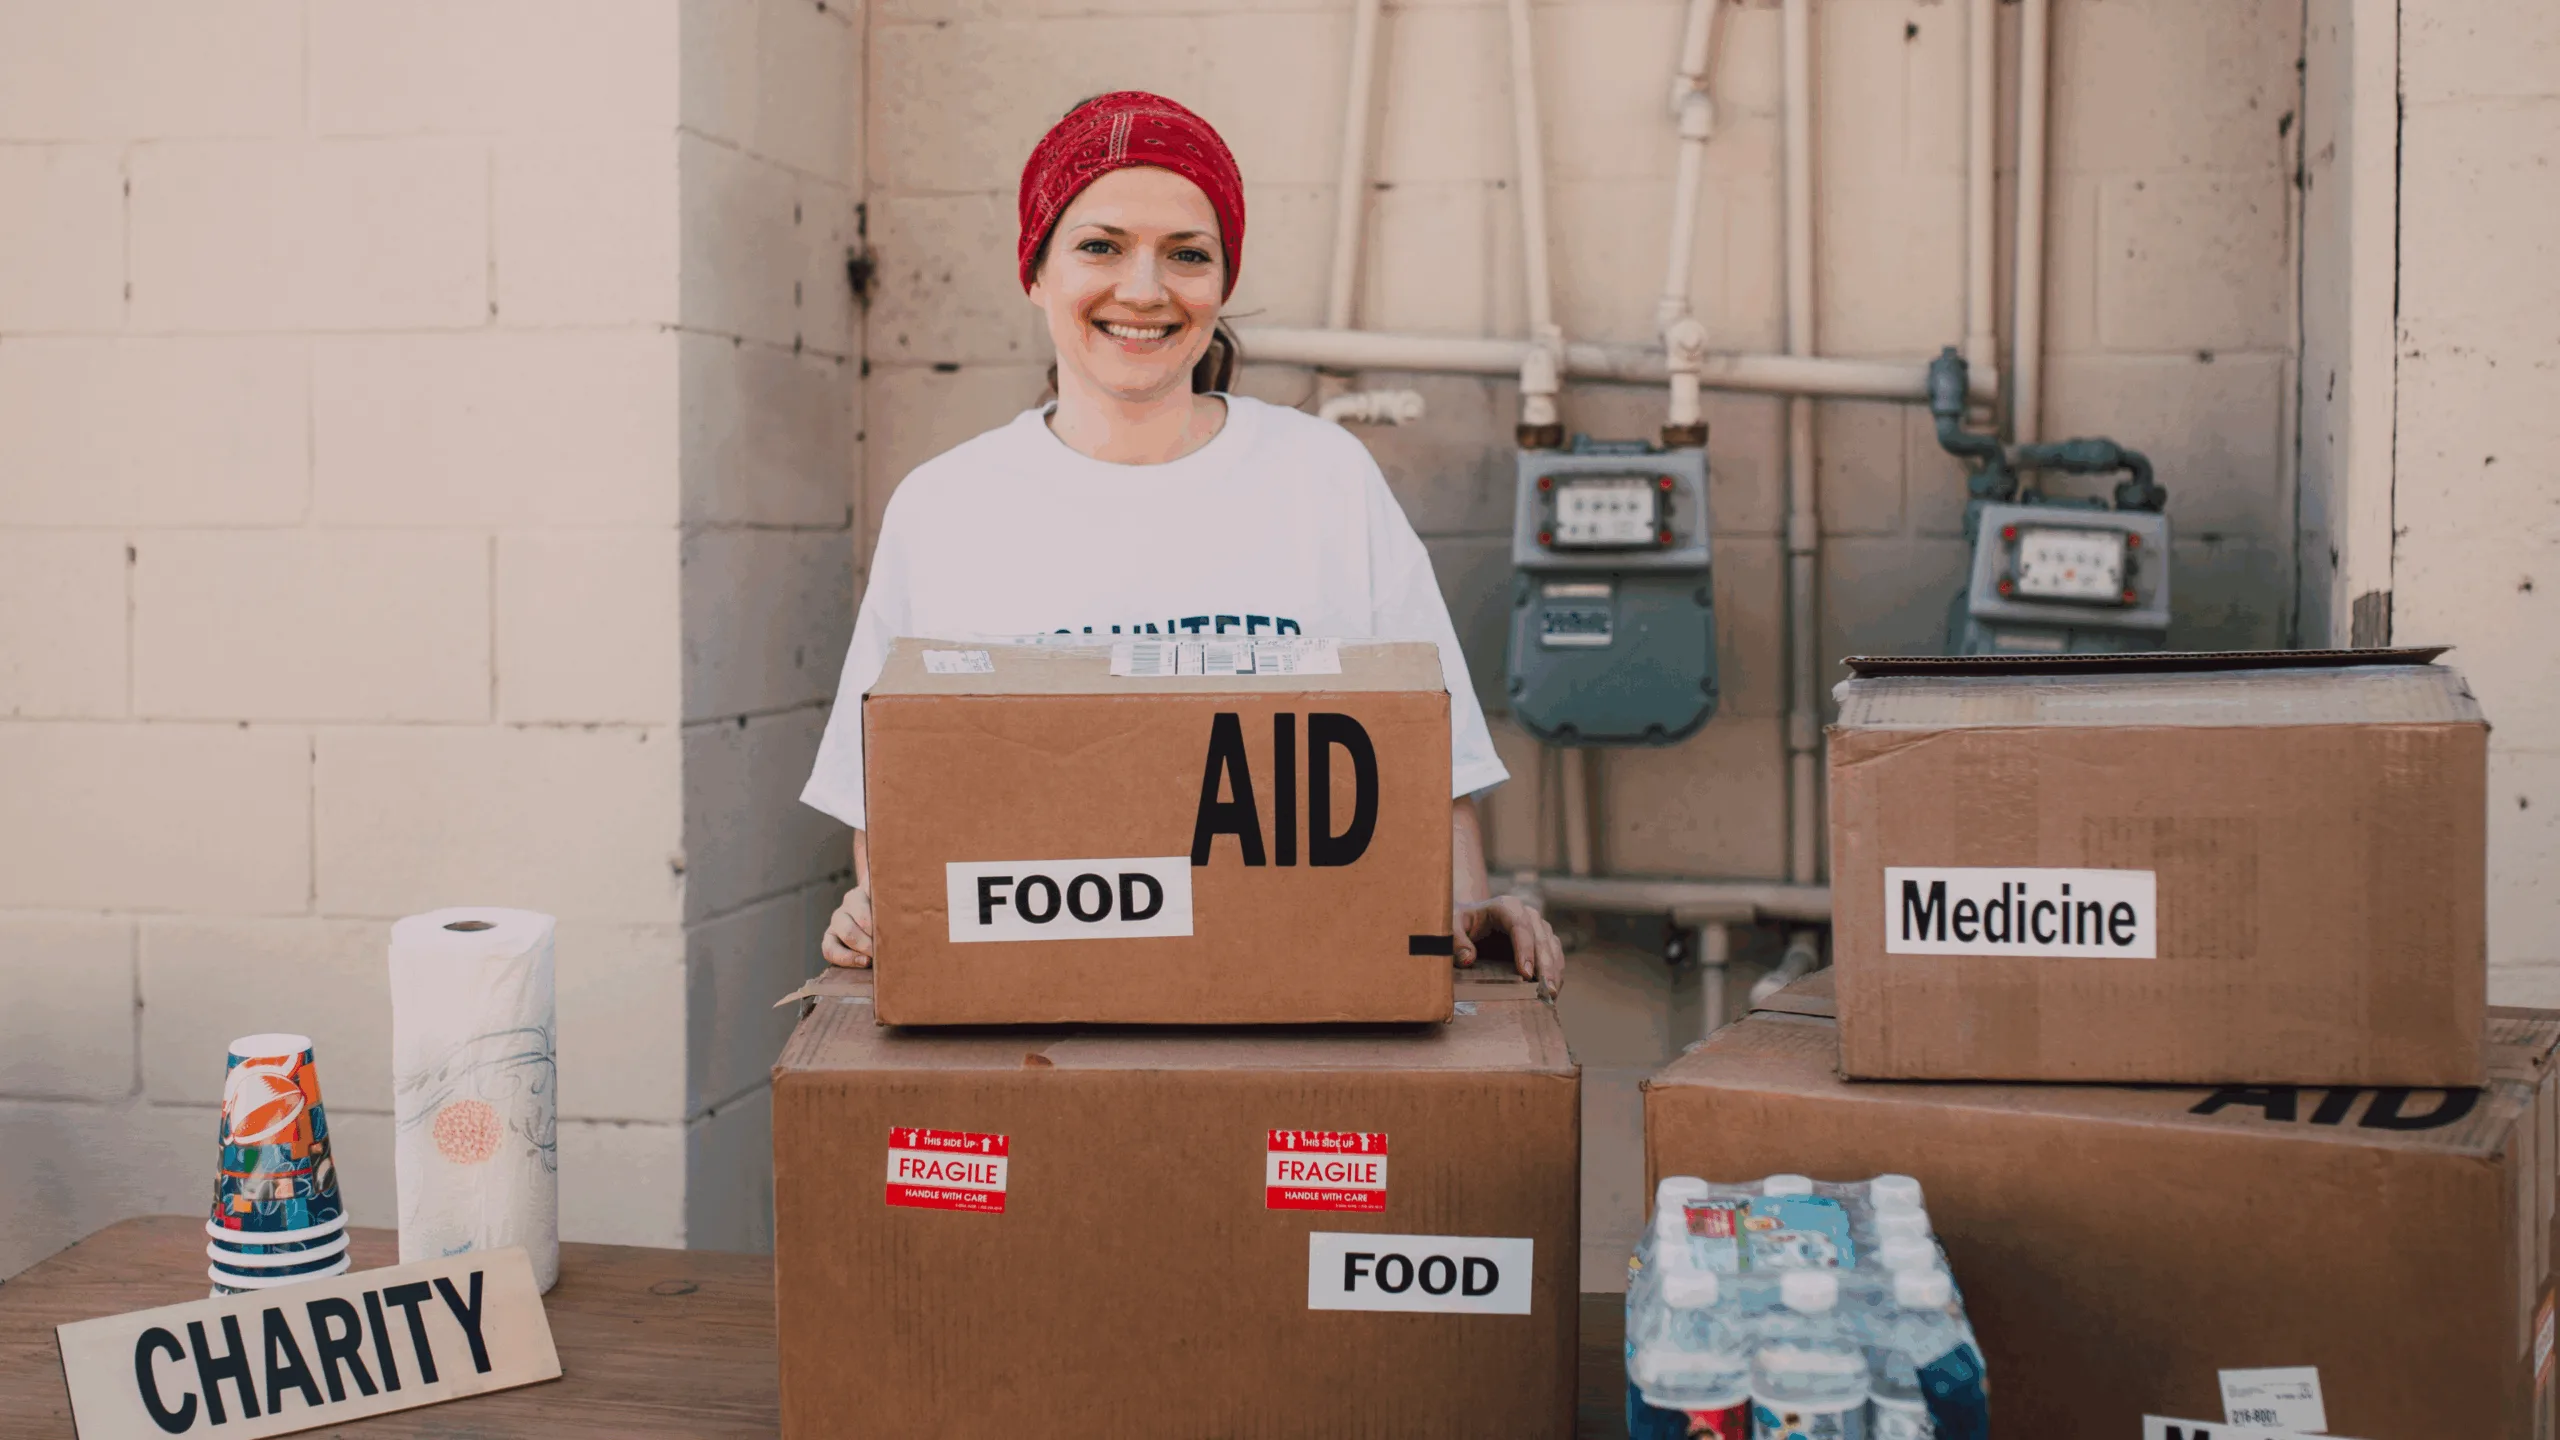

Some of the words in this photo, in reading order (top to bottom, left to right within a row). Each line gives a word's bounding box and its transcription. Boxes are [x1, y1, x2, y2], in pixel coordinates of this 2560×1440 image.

[1191, 712, 1379, 867] AID
[977, 873, 1164, 925] FOOD
[1902, 880, 2136, 947] Medicine
[924, 1136, 941, 1147] THIS
[943, 1138, 961, 1148] SIDE
[964, 1140, 976, 1149] UP
[1302, 1138, 1320, 1148] THIS
[1322, 1139, 1341, 1149] SIDE
[1342, 1140, 1355, 1149] UP
[899, 1157, 998, 1184] FRAGILE
[1278, 1160, 1377, 1183] FRAGILE
[905, 1189, 939, 1200] HANDLE
[942, 1191, 962, 1201] WITH
[964, 1193, 988, 1203] CARE
[1285, 1191, 1319, 1201] HANDLE
[1321, 1192, 1342, 1201] WITH
[1344, 1193, 1368, 1203] CARE
[1344, 1252, 1499, 1297] FOOD
[134, 1271, 492, 1435] CHARITY
